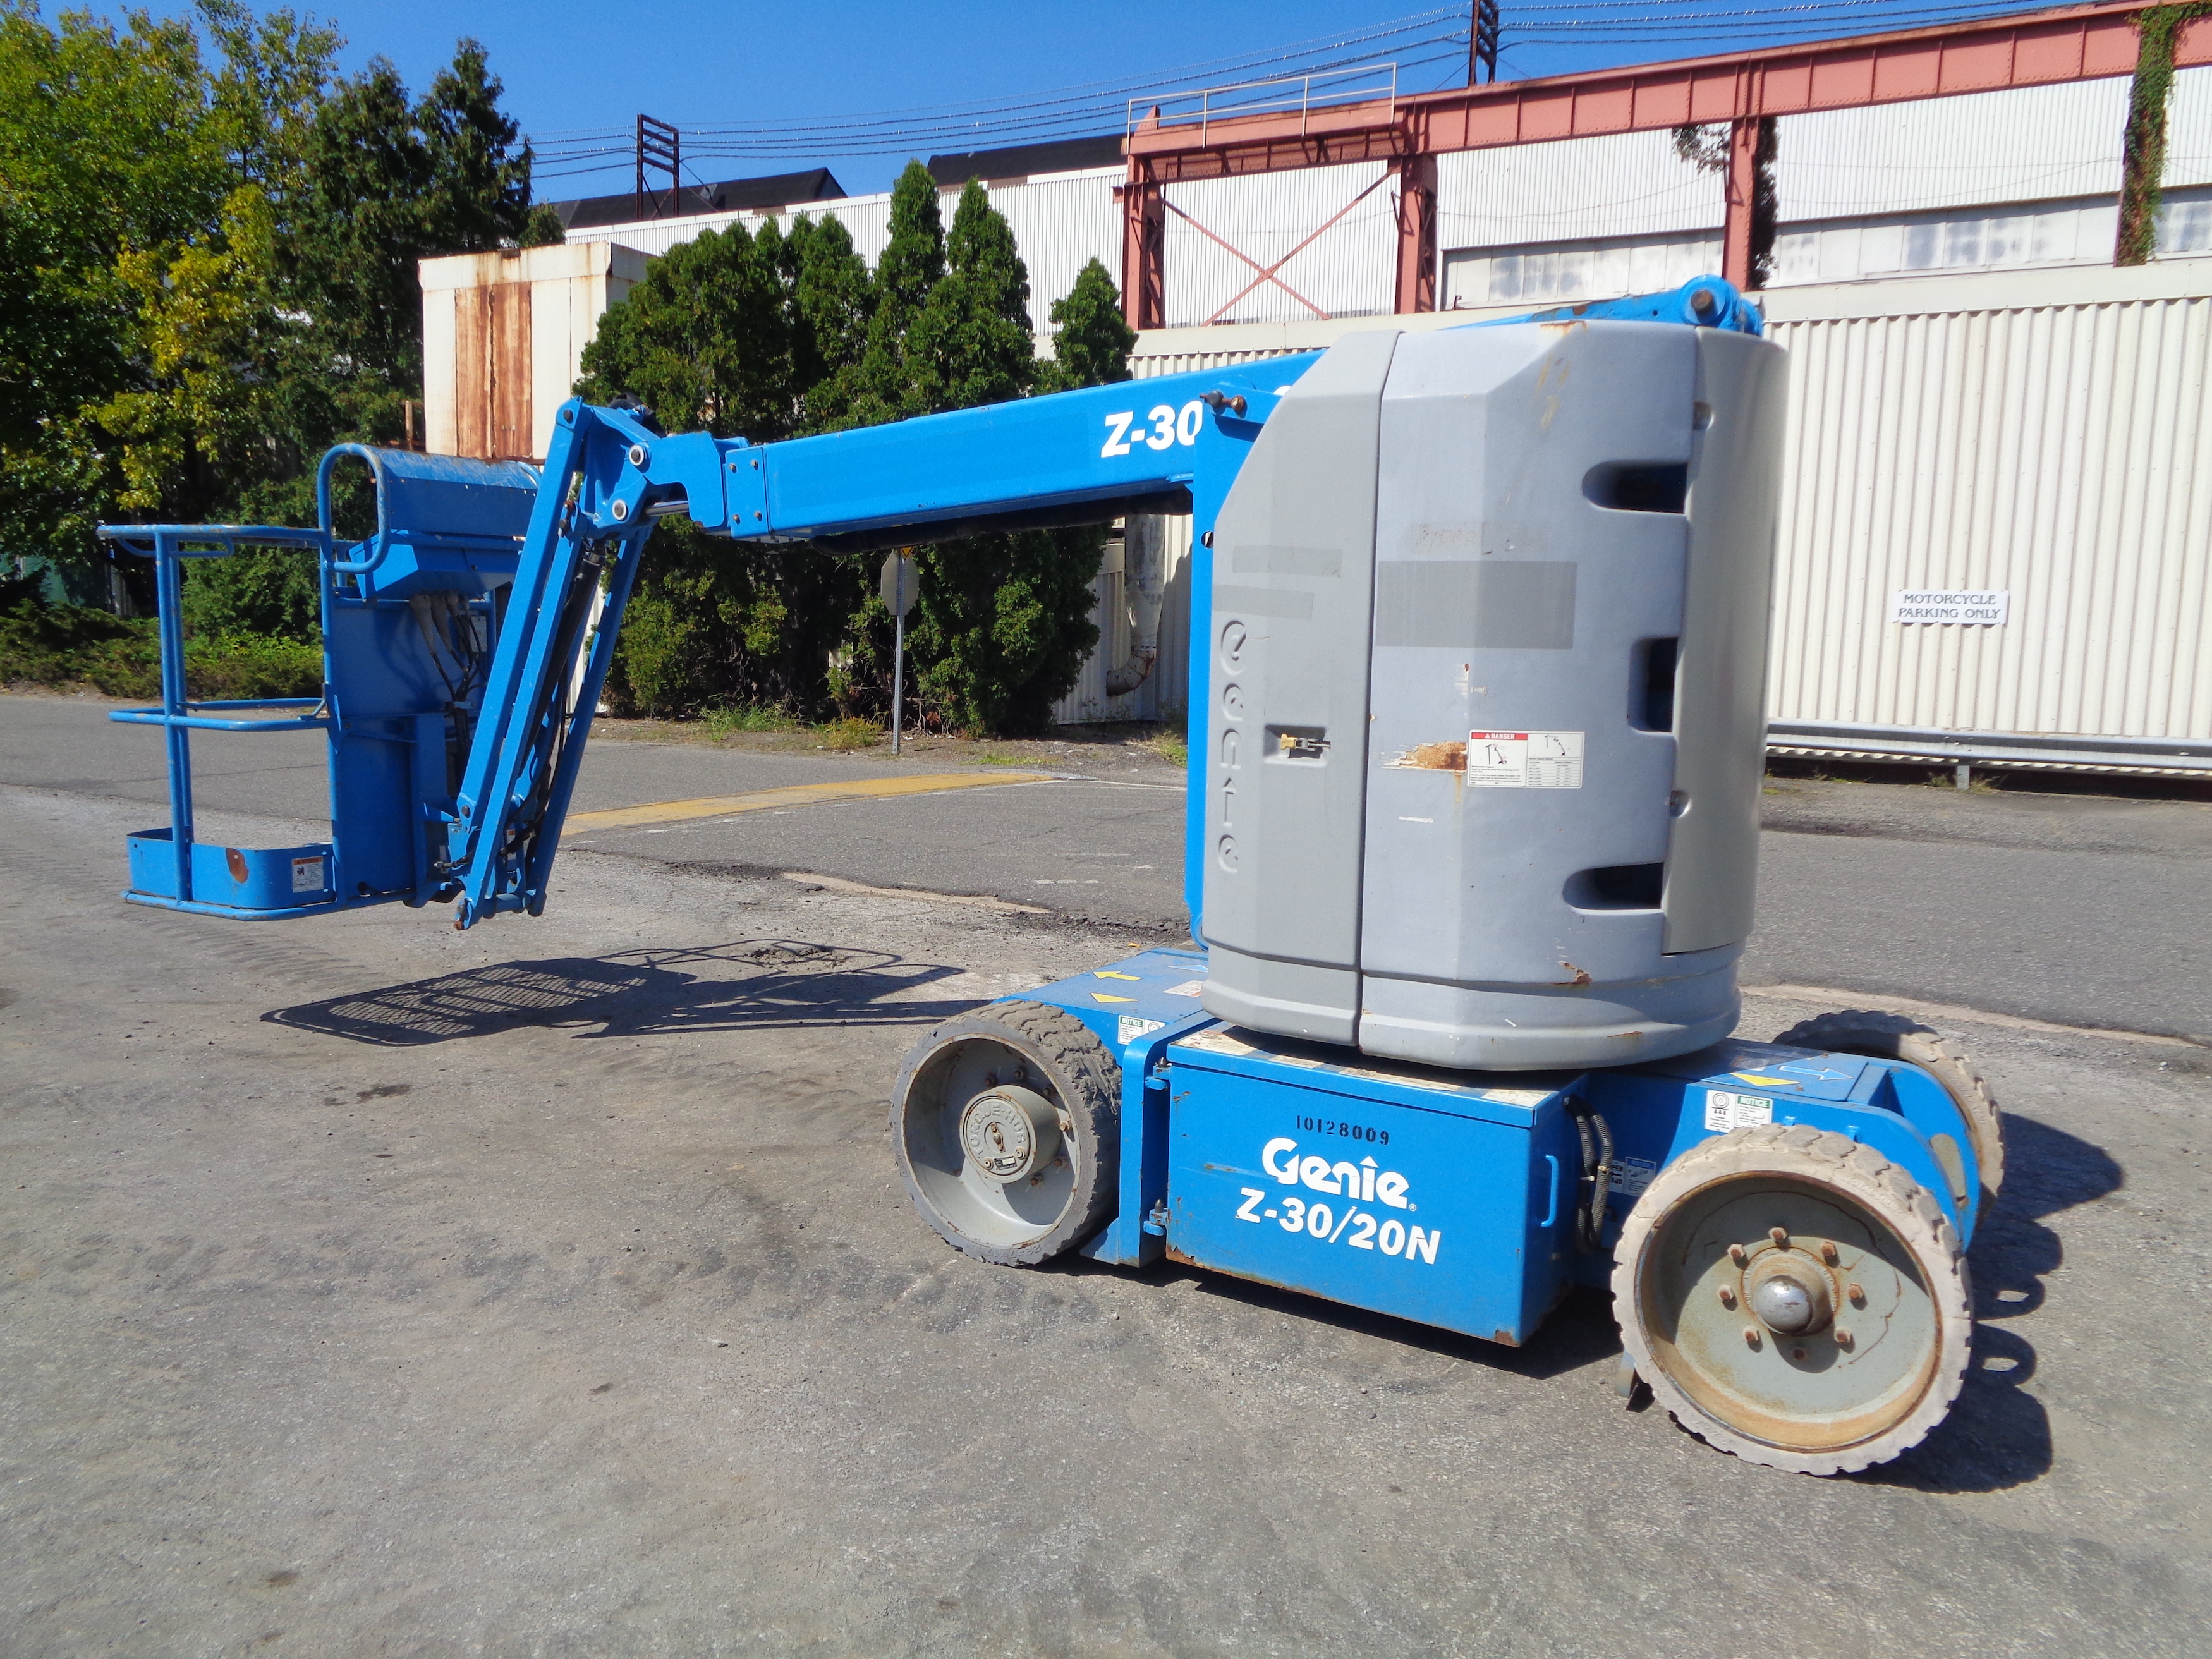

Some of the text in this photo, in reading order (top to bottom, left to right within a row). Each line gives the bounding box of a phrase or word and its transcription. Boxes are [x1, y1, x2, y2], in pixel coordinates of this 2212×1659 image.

[1903, 594, 1996, 604] MOTORCYCLE
[1899, 608, 2001, 619] PARKING ONLY
[1122, 1017, 1141, 1026] NOTICE
[1740, 1097, 1769, 1108] NOTICE
[969, 1102, 1026, 1159] TORQUE-HUB
[1297, 1115, 1389, 1145] 10128009
[1262, 1138, 1411, 1209] Genie
[1235, 1187, 1441, 1265] Z-30/20N
